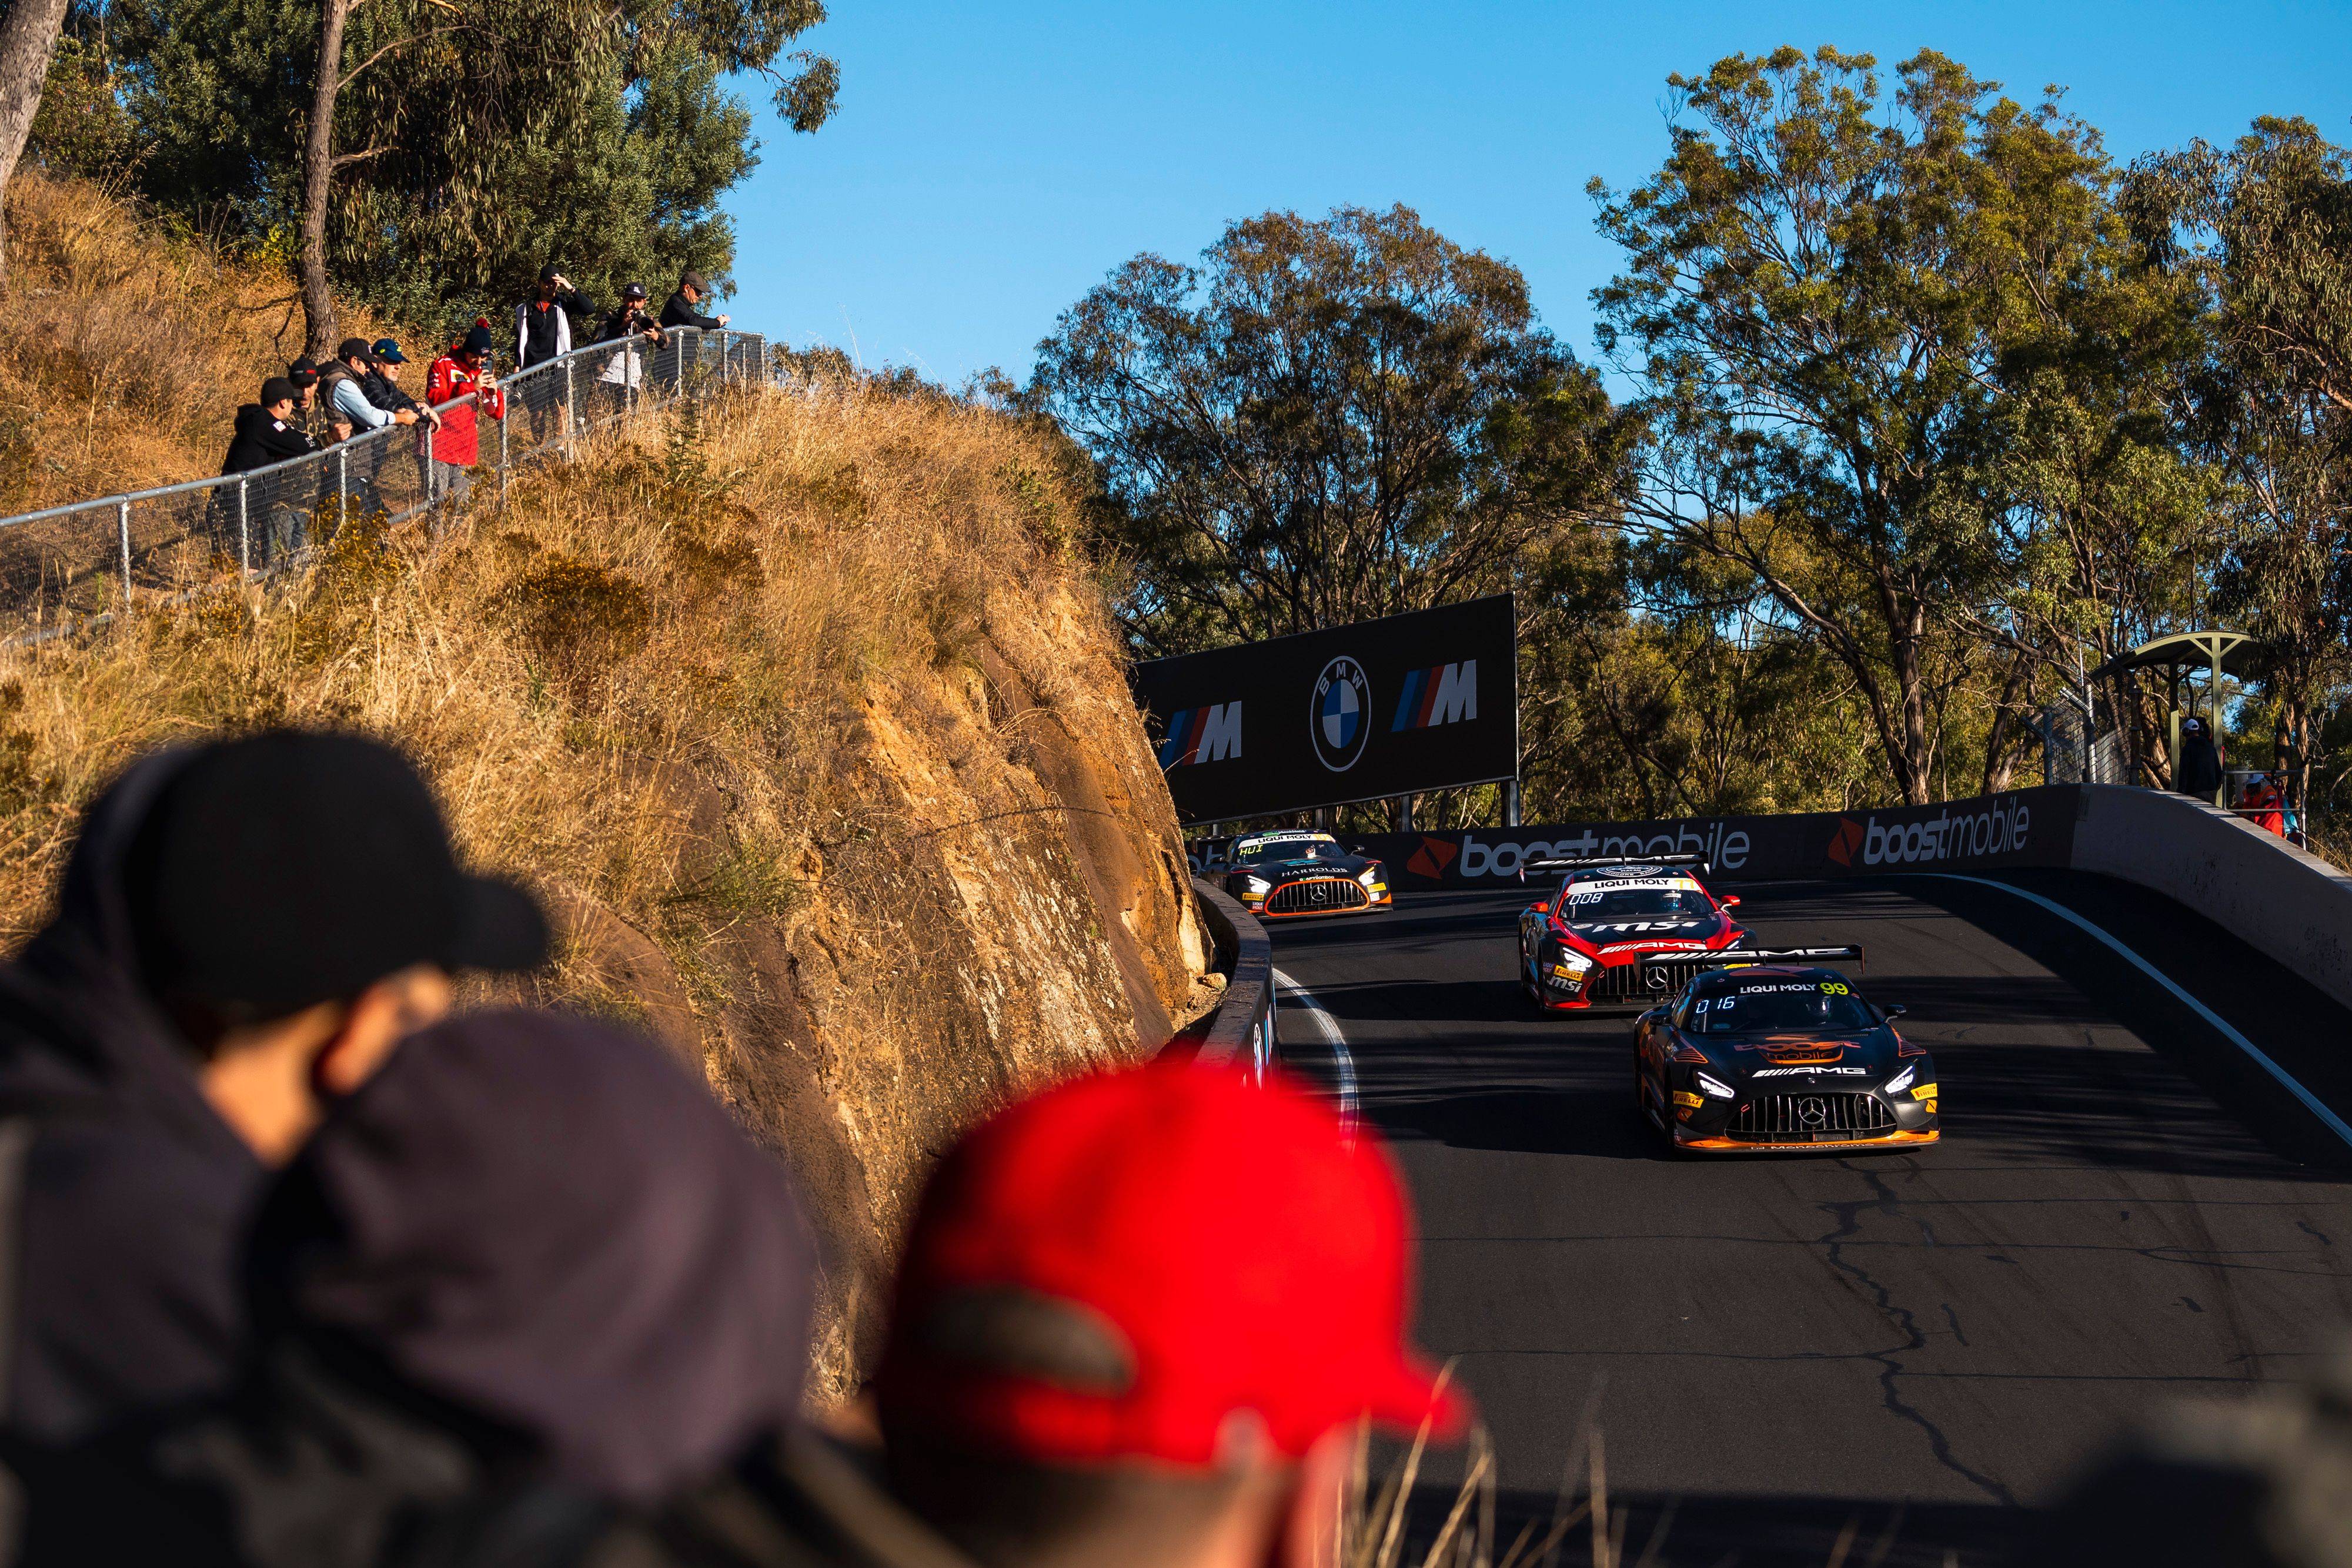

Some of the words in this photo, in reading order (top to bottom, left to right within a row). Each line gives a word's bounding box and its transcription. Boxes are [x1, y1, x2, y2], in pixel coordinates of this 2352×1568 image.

[1319, 662, 1363, 696] BMW
[1240, 844, 1264, 856] HUI
[1281, 867, 1348, 877] HARROLDS
[1594, 880, 1629, 889] LIQUI
[1673, 880, 1695, 890] 77
[1568, 892, 1604, 906] 008
[1633, 942, 1708, 950] AMG
[1556, 968, 1581, 979] PIRELLI
[1547, 976, 1583, 993] msi
[1740, 984, 1777, 994] LIQUI
[1780, 984, 1816, 992] MOLY
[1820, 982, 1849, 995] 99
[1767, 1051, 1834, 1060] mobile
